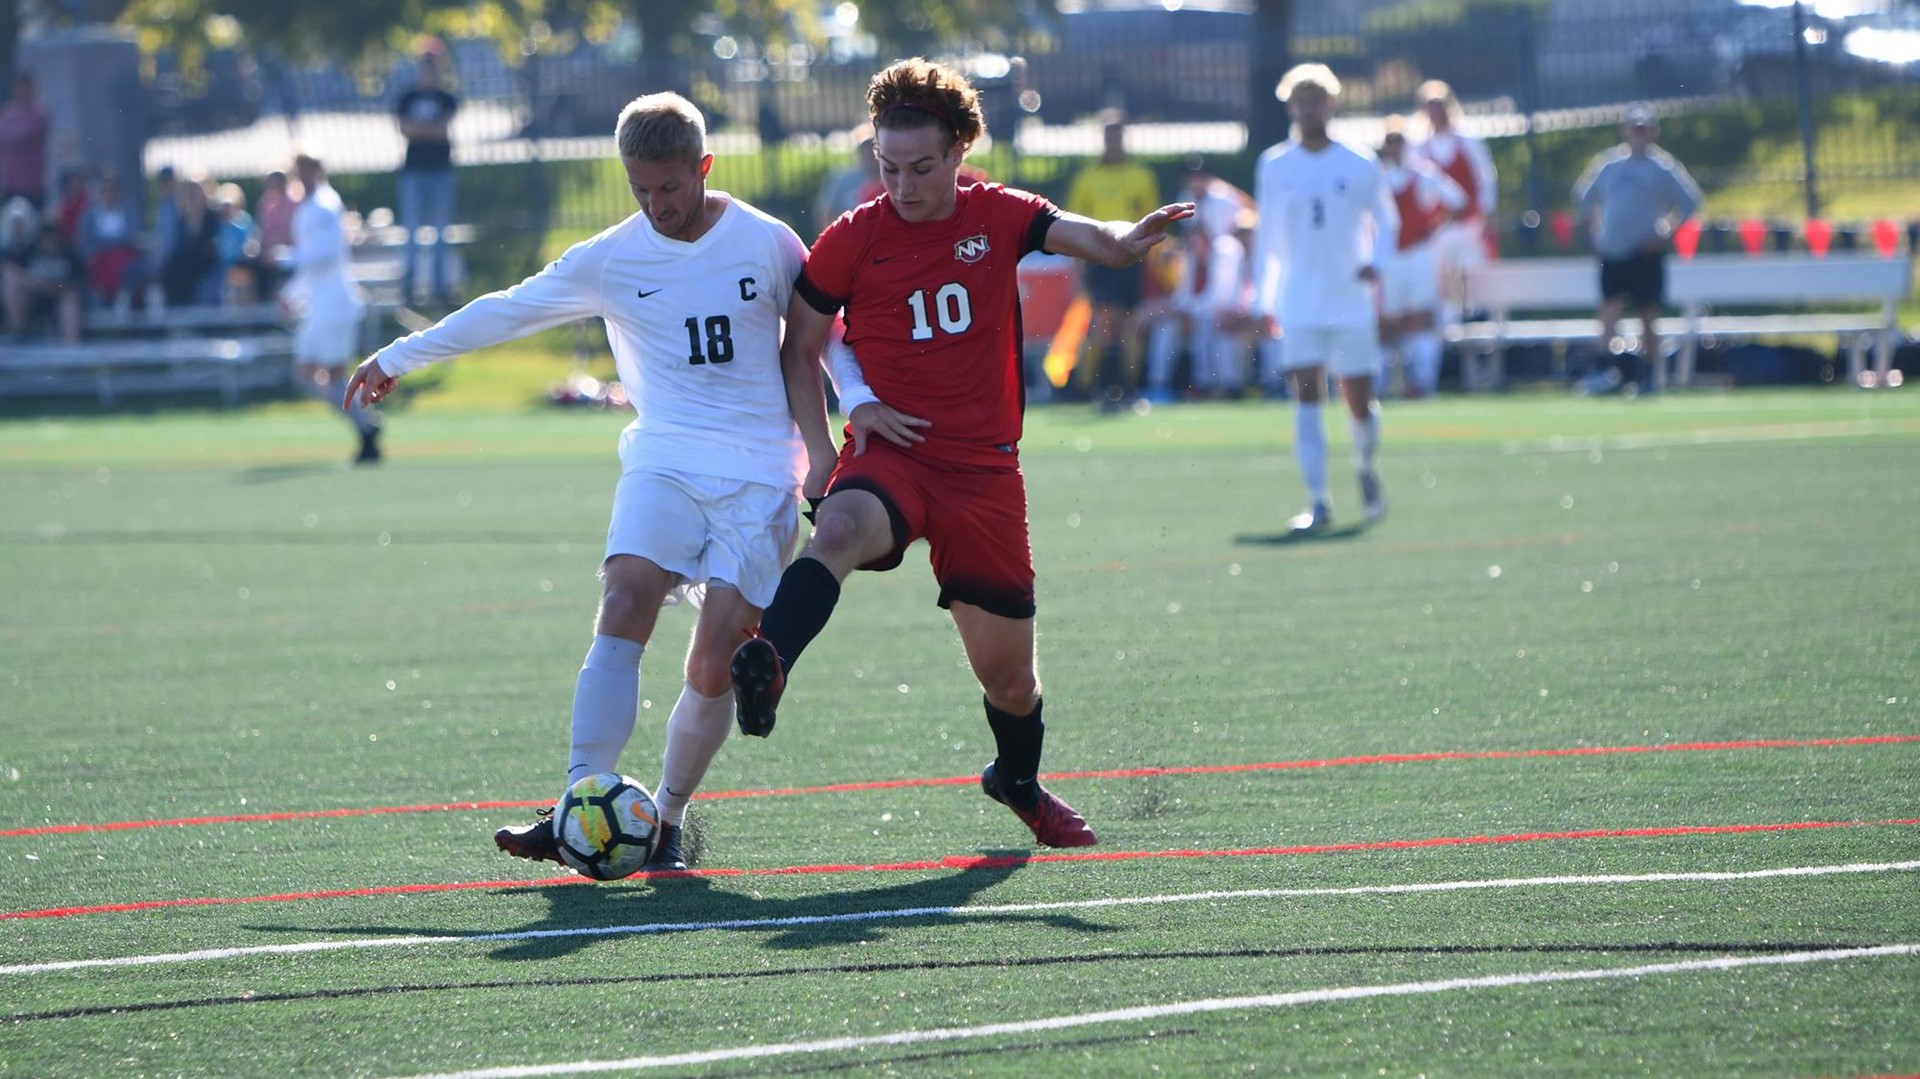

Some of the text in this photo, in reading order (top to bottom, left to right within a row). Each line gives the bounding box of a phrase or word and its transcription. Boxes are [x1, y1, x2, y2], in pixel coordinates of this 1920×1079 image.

[958, 238, 987, 257] NN
[738, 277, 757, 301] C
[907, 282, 972, 340] 10
[684, 314, 734, 365] 18
